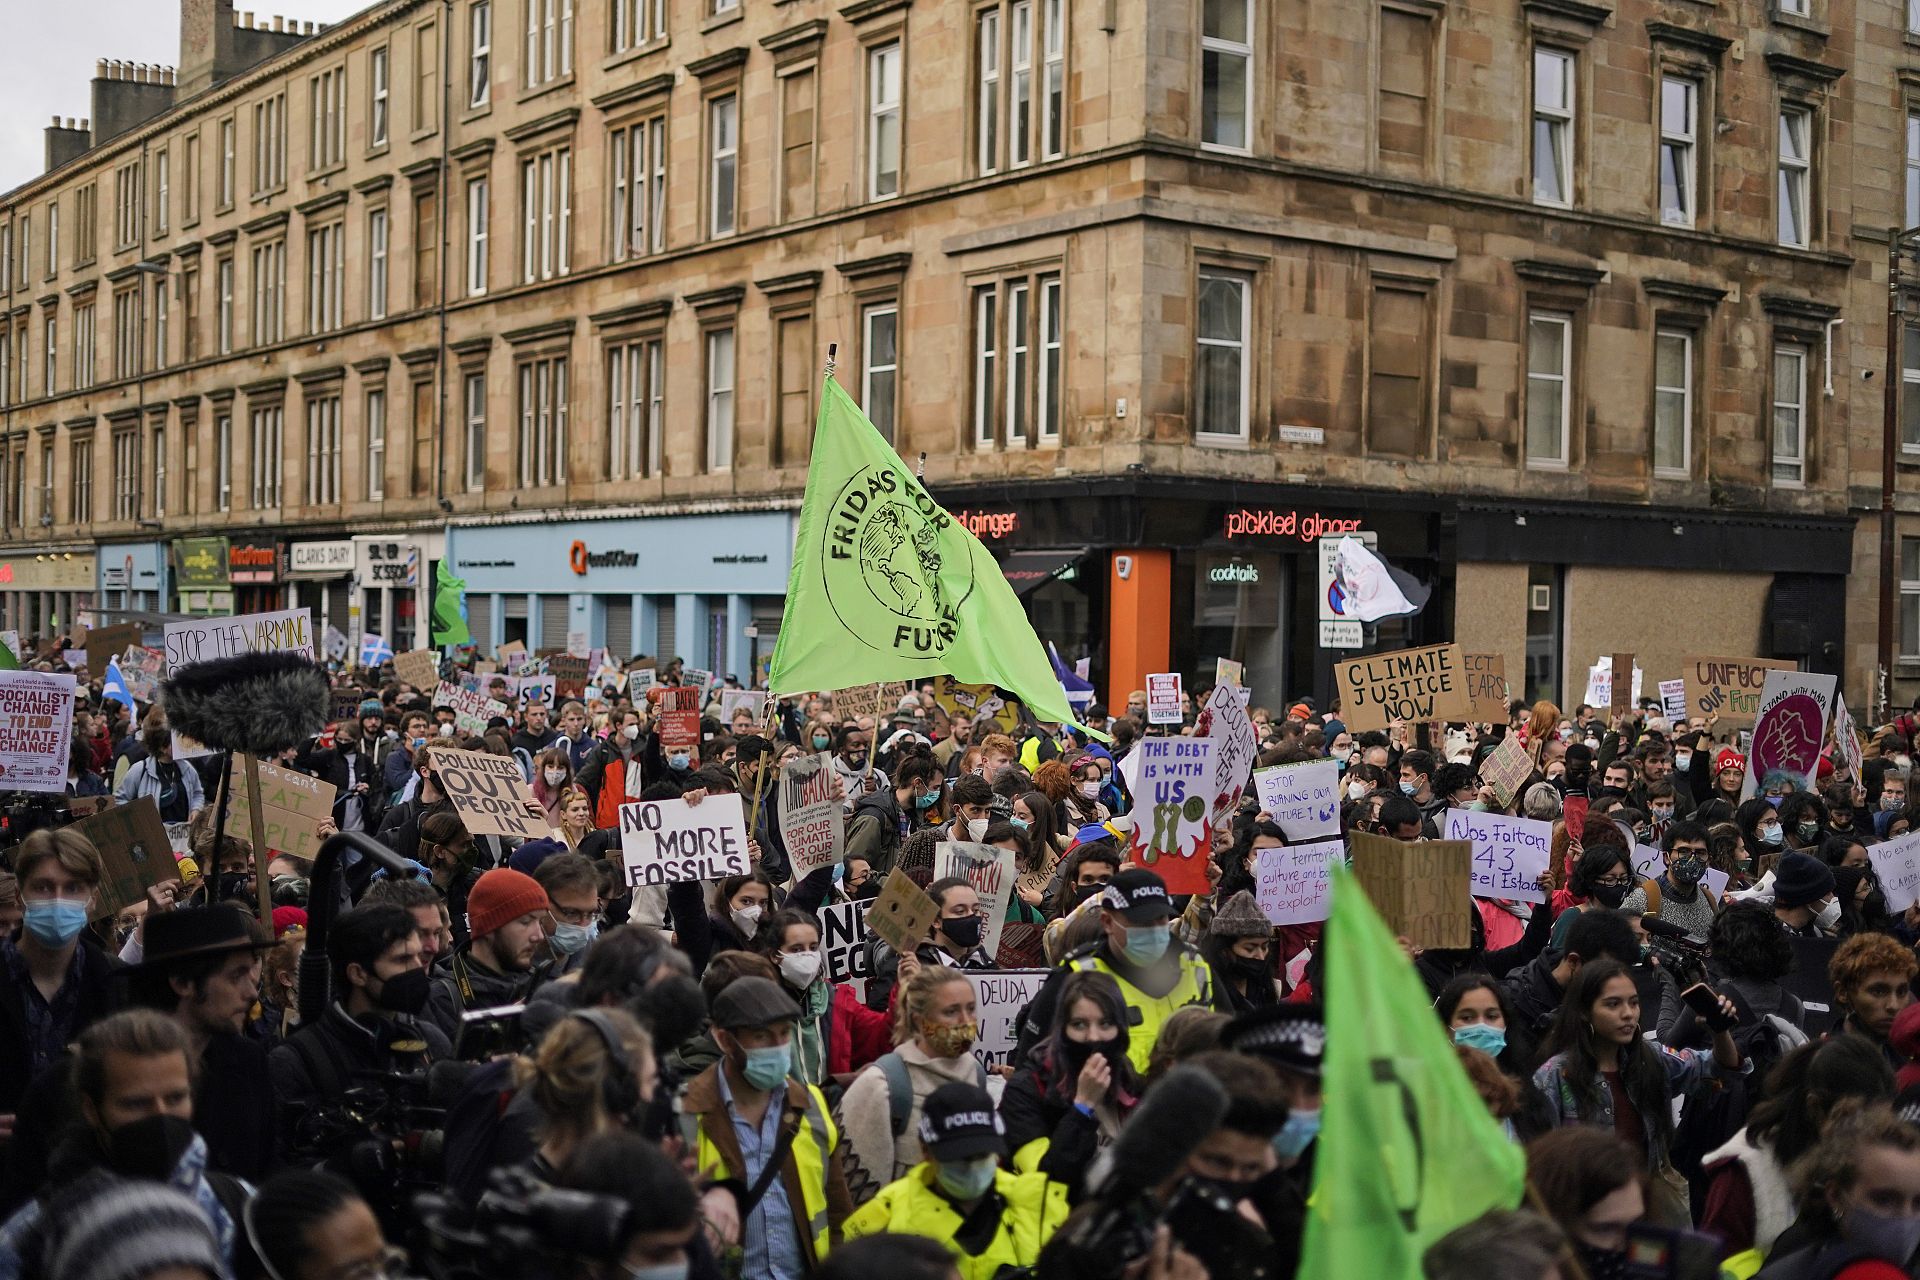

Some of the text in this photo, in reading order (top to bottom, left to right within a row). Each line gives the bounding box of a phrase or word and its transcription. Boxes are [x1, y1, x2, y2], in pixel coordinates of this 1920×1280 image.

[831, 469, 950, 560] FRIDAS FOR
[1227, 509, 1362, 542] pickled ginger
[296, 547, 350, 564] CLARKS DAIRY
[1210, 563, 1258, 582] cocktails
[166, 615, 308, 664] STOP THE WARMING
[1339, 626, 1351, 635] only
[1348, 648, 1453, 686] CLIMATE
[0, 689, 70, 704] SOCIALIST
[440, 680, 489, 707] NO NEW
[836, 695, 855, 707] KILL
[856, 692, 871, 702] THE
[1353, 674, 1454, 706] JUSTICE
[1699, 686, 1727, 712] OUR
[3, 701, 60, 715] CHANGE
[1383, 695, 1434, 723] NOW
[1762, 686, 1827, 716] STAND WITH MAPA
[9, 715, 53, 729] TO END
[1152, 711, 1180, 719] TOGETHER
[0, 728, 60, 743] CLIMATE
[0, 740, 57, 755] CHANGE
[1144, 742, 1209, 758] THE DEBT
[1221, 734, 1240, 770] THE
[435, 752, 519, 776] POLLUTERS
[1145, 763, 1203, 778] IS WITH
[1719, 758, 1745, 769] LOVE
[441, 768, 522, 800] OUT
[785, 767, 831, 813] LANDBACK!
[1155, 780, 1186, 804] US
[1266, 775, 1295, 790] STOP
[451, 793, 541, 820] PEOPLE
[1266, 786, 1332, 808] BURNING OUR
[621, 804, 662, 833] NO
[816, 810, 832, 818] now!
[494, 815, 528, 835] IN
[787, 820, 830, 840] FOR OUR
[1451, 816, 1548, 853] Nos Faltan
[655, 826, 739, 859] MORE
[789, 830, 835, 851] CLIMATE,
[792, 841, 832, 860] FOR OUR
[796, 851, 832, 872] FUTURE
[1261, 851, 1284, 868] Our
[1475, 845, 1516, 872] 43
[1878, 849, 1892, 860] No
[629, 856, 743, 886] FOSSILS
[1026, 857, 1056, 890] PLANET
[1263, 869, 1299, 884] culture
[1303, 868, 1316, 879] and
[1132, 886, 1166, 899] POLICE
[1262, 880, 1328, 897] are NOT for
[1501, 873, 1547, 892] Estado
[1261, 902, 1272, 912] to
[980, 978, 1029, 1007] DEUDA
[944, 1111, 991, 1131] POLICE
